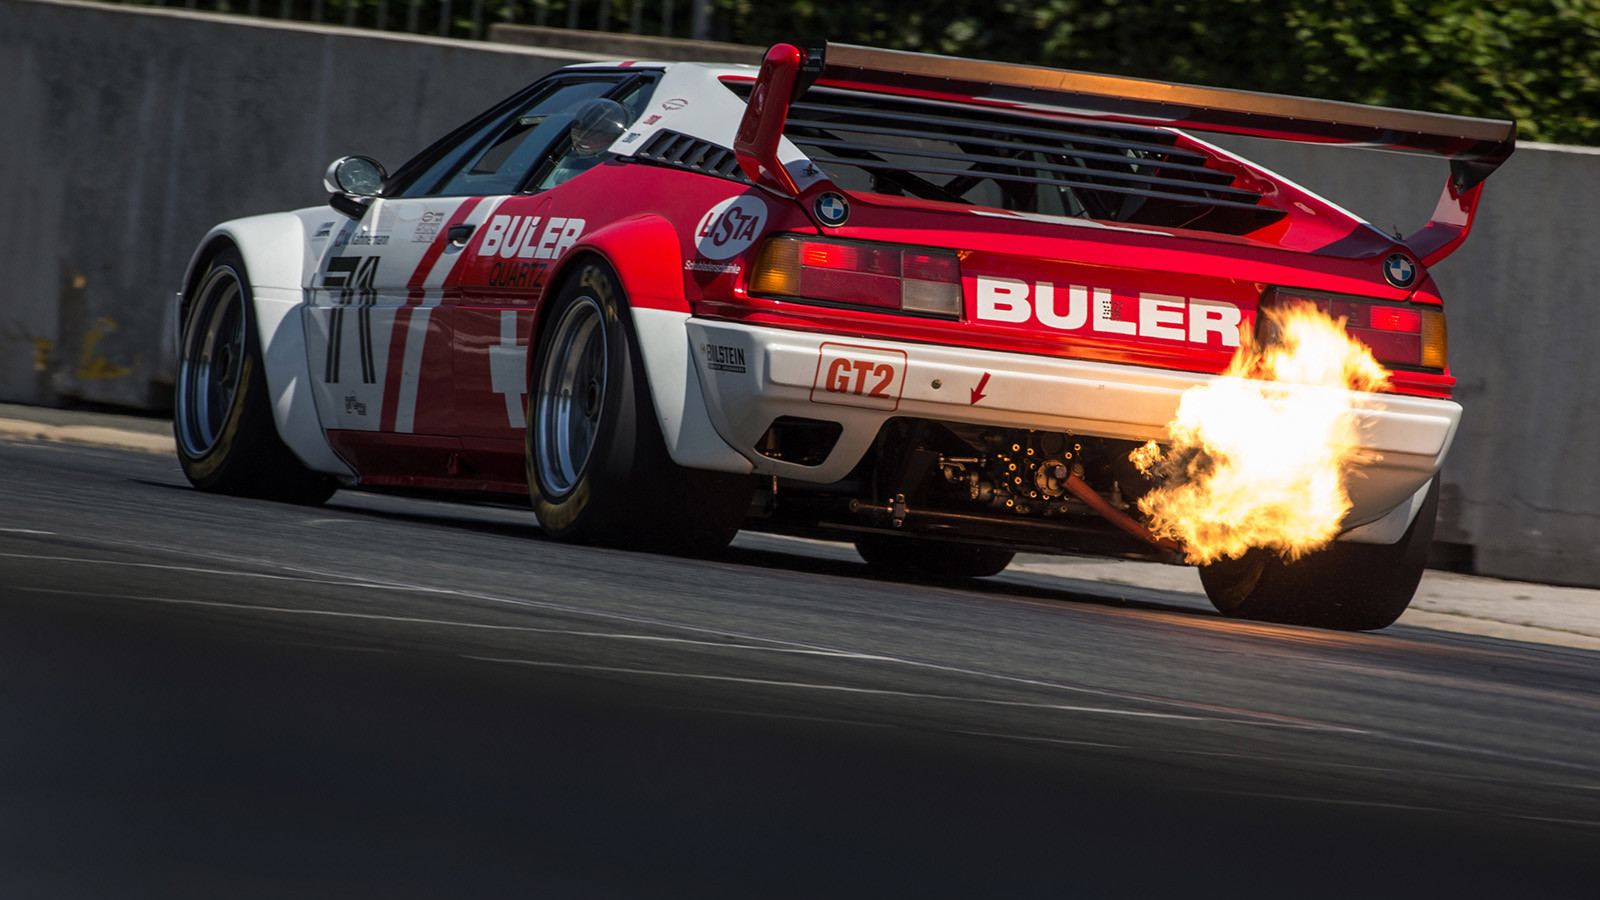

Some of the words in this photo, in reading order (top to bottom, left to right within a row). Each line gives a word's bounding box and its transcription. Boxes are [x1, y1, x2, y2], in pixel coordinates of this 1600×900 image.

[478, 215, 586, 260] BULER
[697, 206, 759, 247] LISTA
[489, 262, 548, 288] QUARTZ
[976, 275, 1242, 347] BULER
[706, 344, 746, 366] BILSTEIN
[825, 358, 895, 399] GT2
